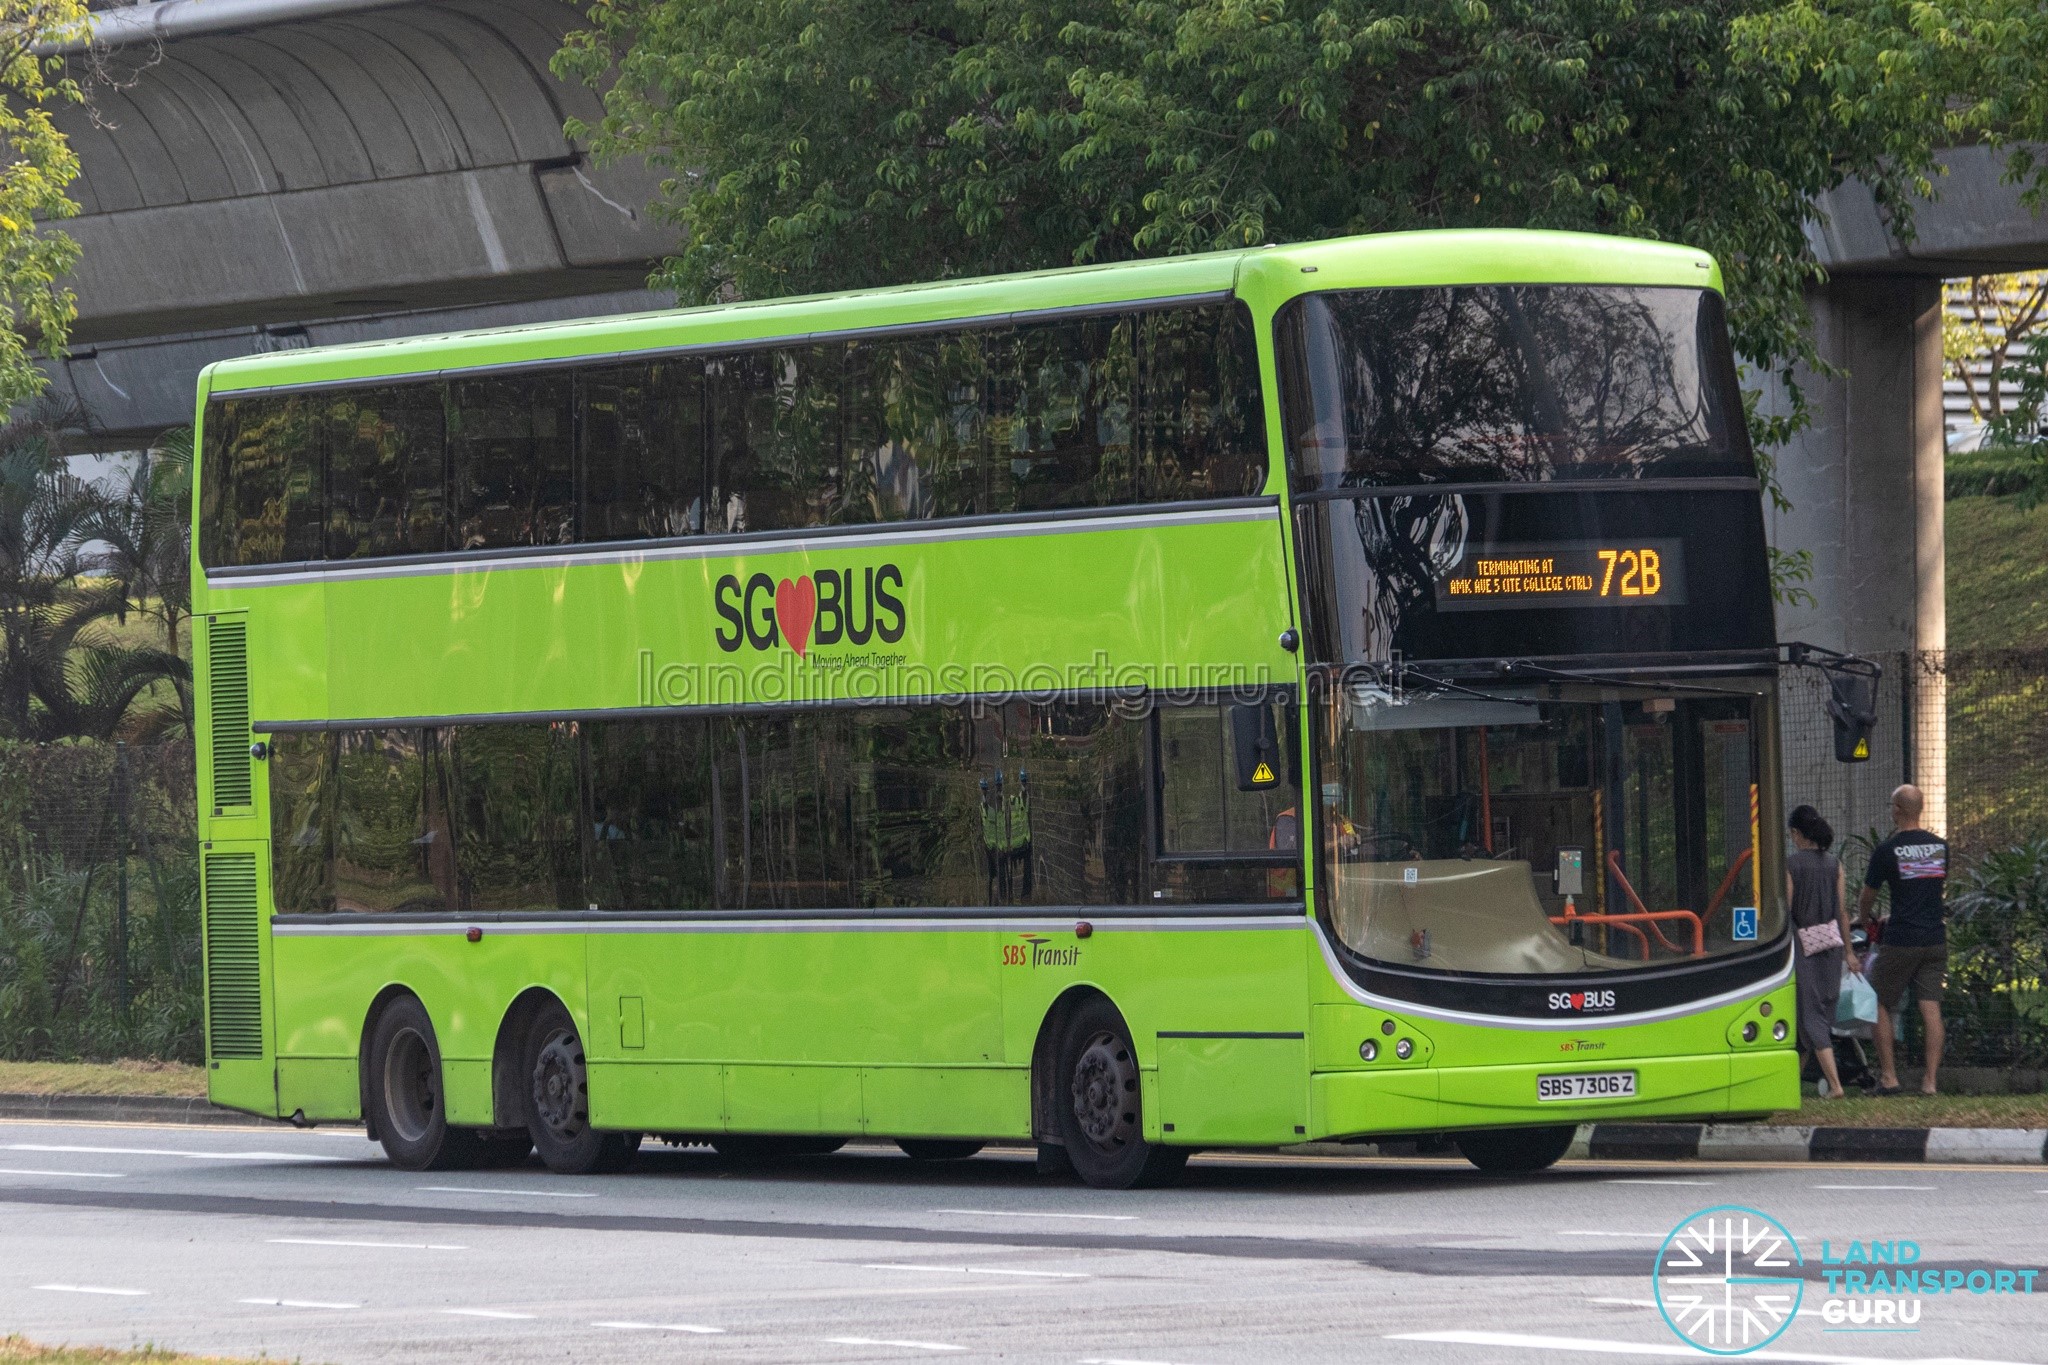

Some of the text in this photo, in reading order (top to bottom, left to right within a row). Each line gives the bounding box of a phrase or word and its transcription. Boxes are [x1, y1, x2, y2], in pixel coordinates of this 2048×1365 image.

[1477, 559, 1554, 576] TERMINATING AT
[1598, 549, 1661, 596] 72B
[1450, 575, 1593, 594] AMK AVE 5 (ITE COLLEGE CTRL)
[715, 563, 906, 652] SG BUS
[812, 652, 907, 670] Moving Ahead Together
[1003, 938, 1082, 970] SBS Transit
[1549, 990, 1616, 1010] SG BUS
[1560, 1040, 1606, 1052] SBS Transit
